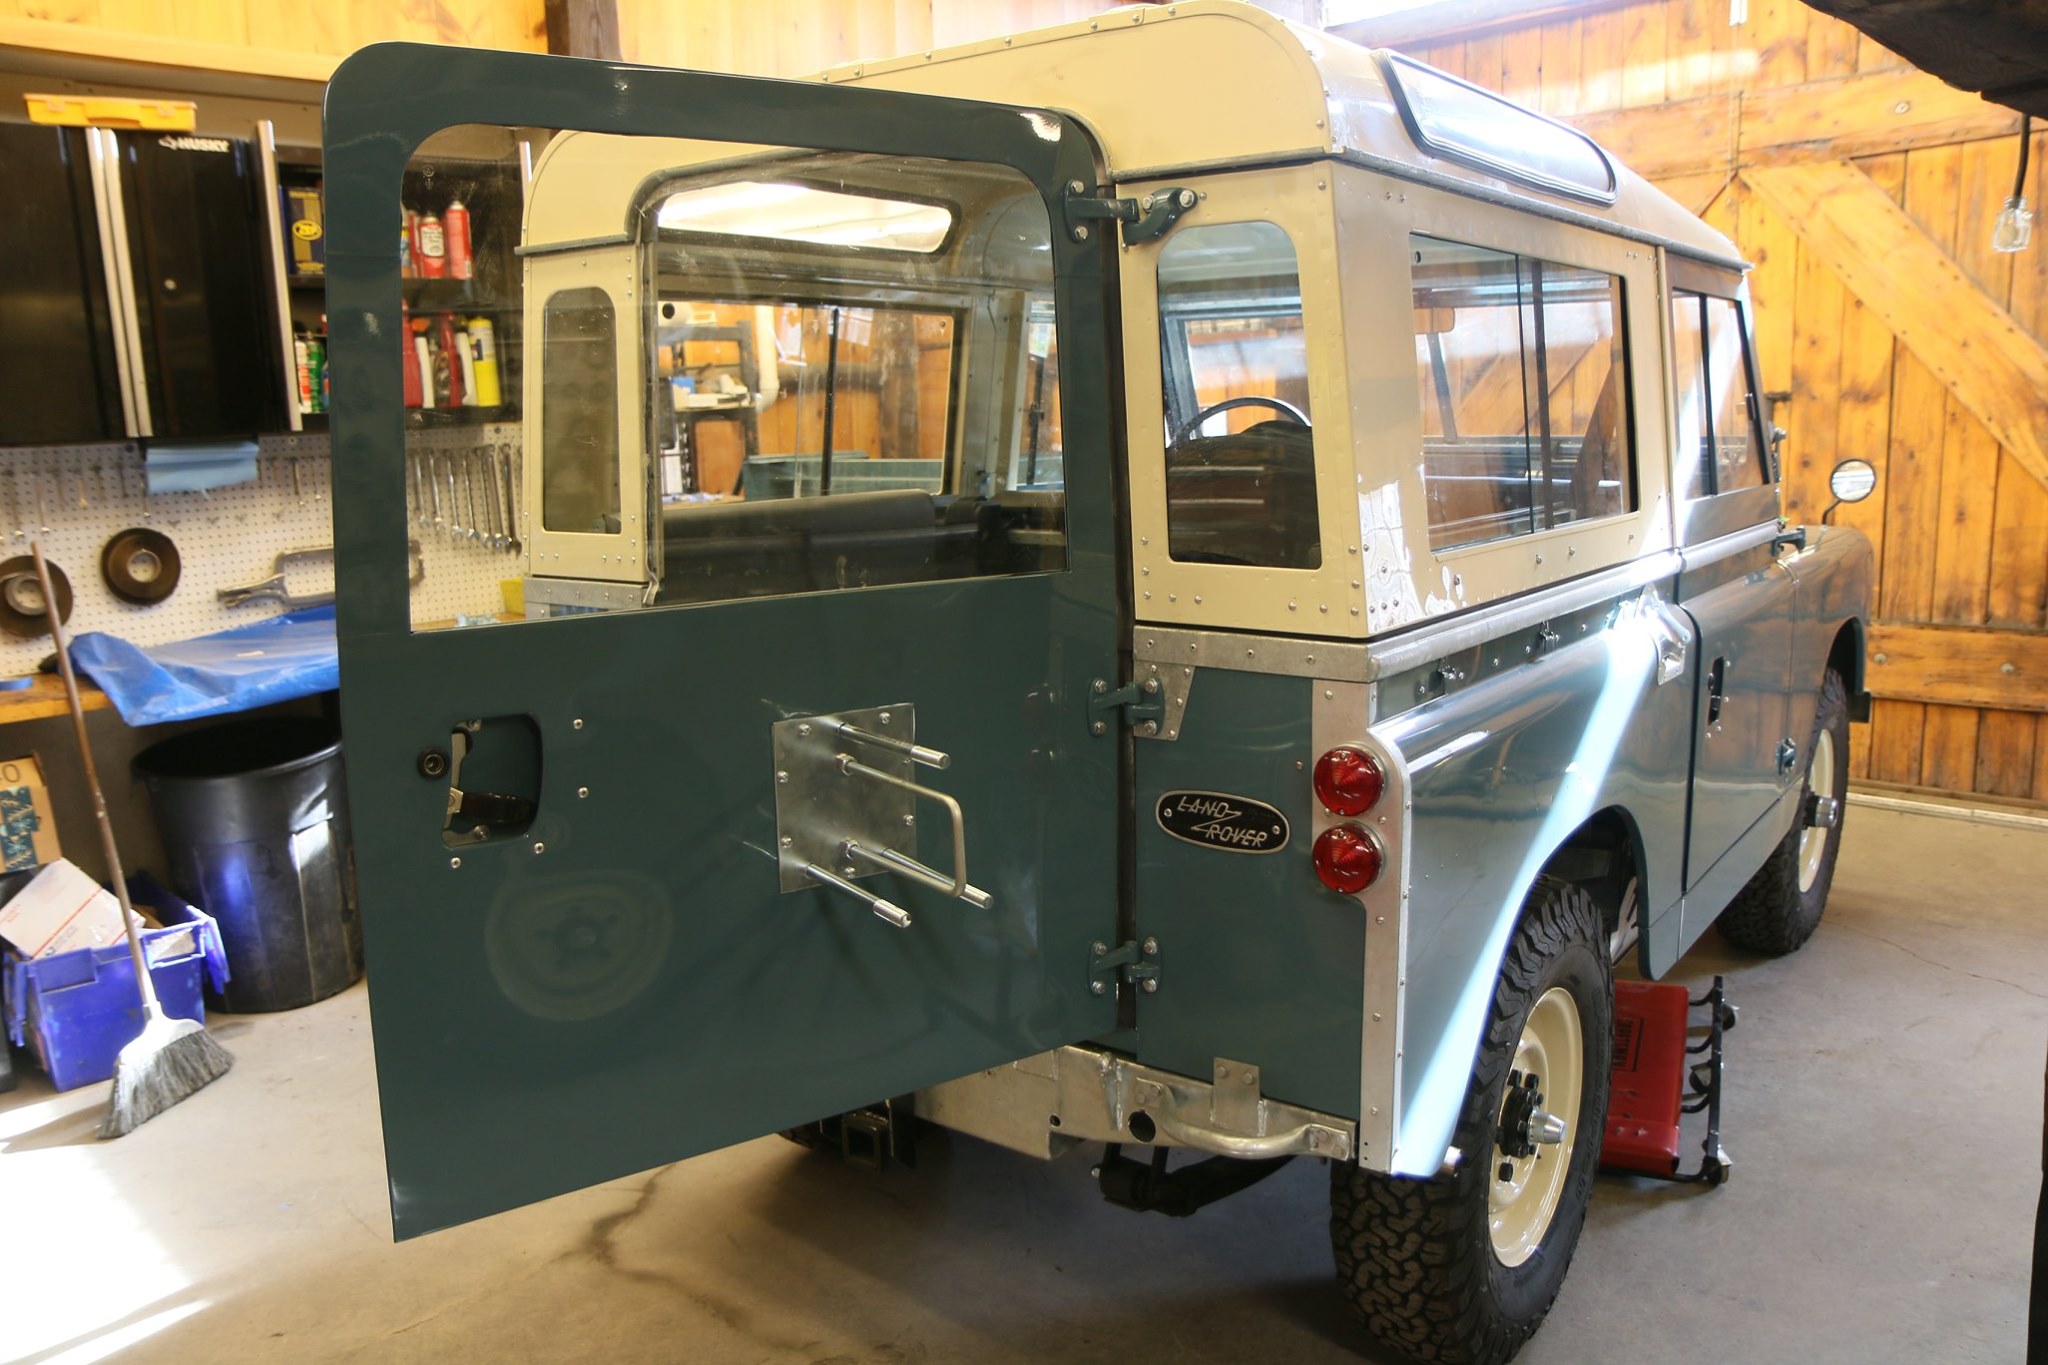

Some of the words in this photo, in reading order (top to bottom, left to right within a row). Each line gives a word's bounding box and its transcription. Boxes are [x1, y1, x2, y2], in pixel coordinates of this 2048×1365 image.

[177, 137, 230, 152] HUSKY
[1177, 796, 1230, 819] LAND
[1206, 824, 1268, 847] ROVER
